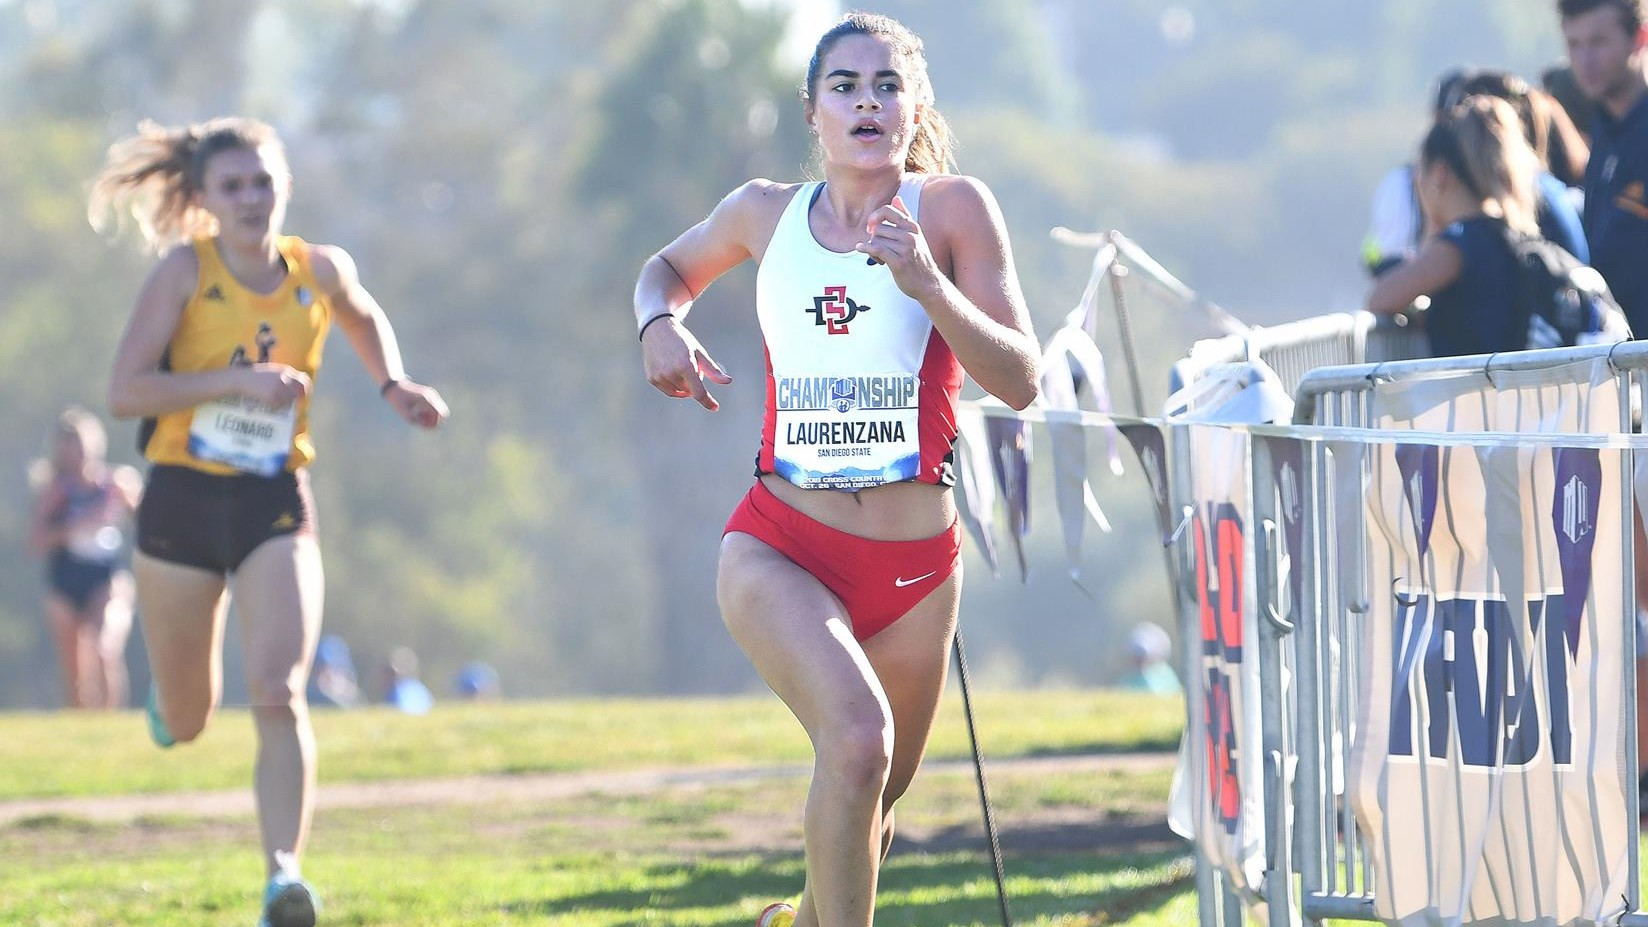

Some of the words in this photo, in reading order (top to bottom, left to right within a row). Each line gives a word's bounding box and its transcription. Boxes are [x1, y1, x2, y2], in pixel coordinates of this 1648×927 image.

[778, 377, 915, 408] CHAMNSHIP
[786, 421, 906, 445] LAURENZANA
[817, 449, 831, 457] SAN
[832, 448, 850, 457] DIEGO
[851, 447, 871, 456] STATE
[850, 475, 888, 483] COUNTRY
